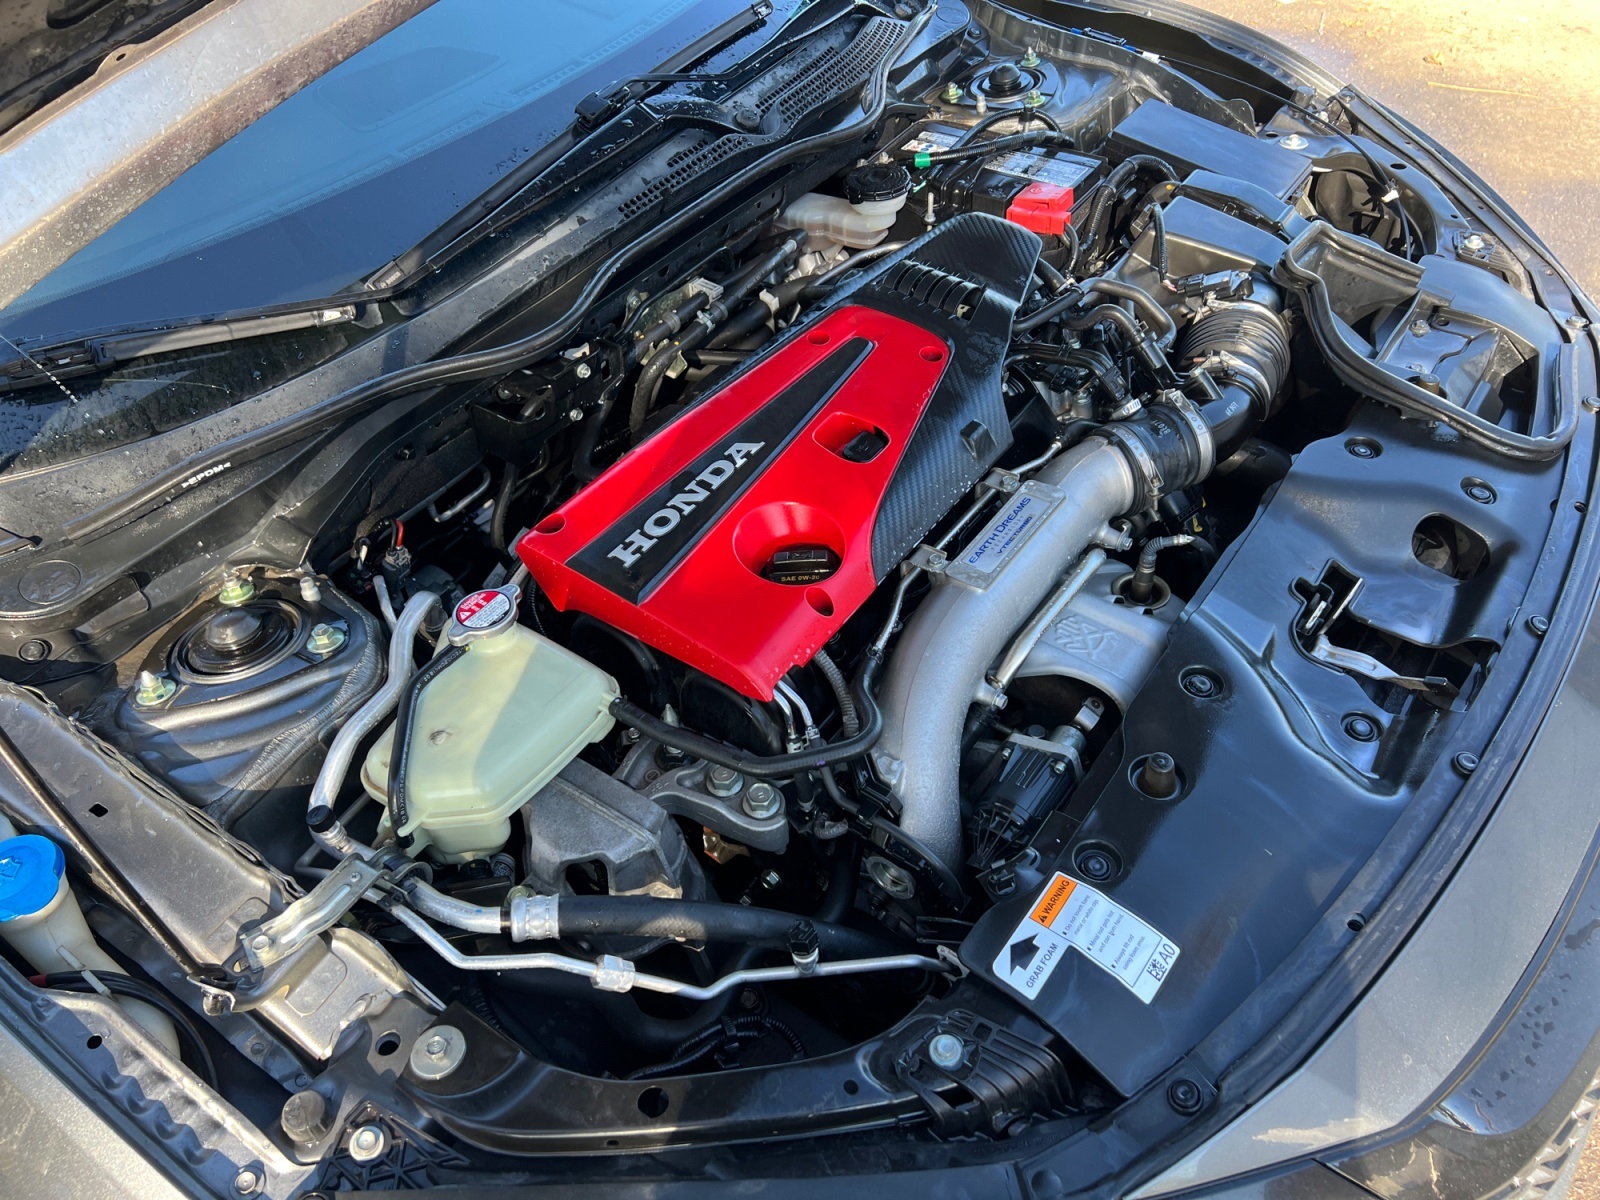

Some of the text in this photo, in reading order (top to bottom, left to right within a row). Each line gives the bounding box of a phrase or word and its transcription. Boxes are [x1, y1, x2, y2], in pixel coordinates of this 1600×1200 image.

[607, 442, 766, 568] HONDA
[968, 497, 1031, 564] EARTH DREAMS
[1042, 880, 1070, 915] WARNING
[1065, 922, 1072, 930] Do
[1074, 904, 1083, 916] touch
[1073, 922, 1083, 935] metal
[1084, 906, 1093, 918] white
[1090, 933, 1099, 946] Metal
[1102, 917, 1111, 928] gets
[1026, 943, 1058, 988] GRAB FOAM
[1114, 948, 1126, 964] Always
[1122, 956, 1133, 970] using
[1130, 946, 1139, 957] foam
[1162, 943, 1176, 965] A0
